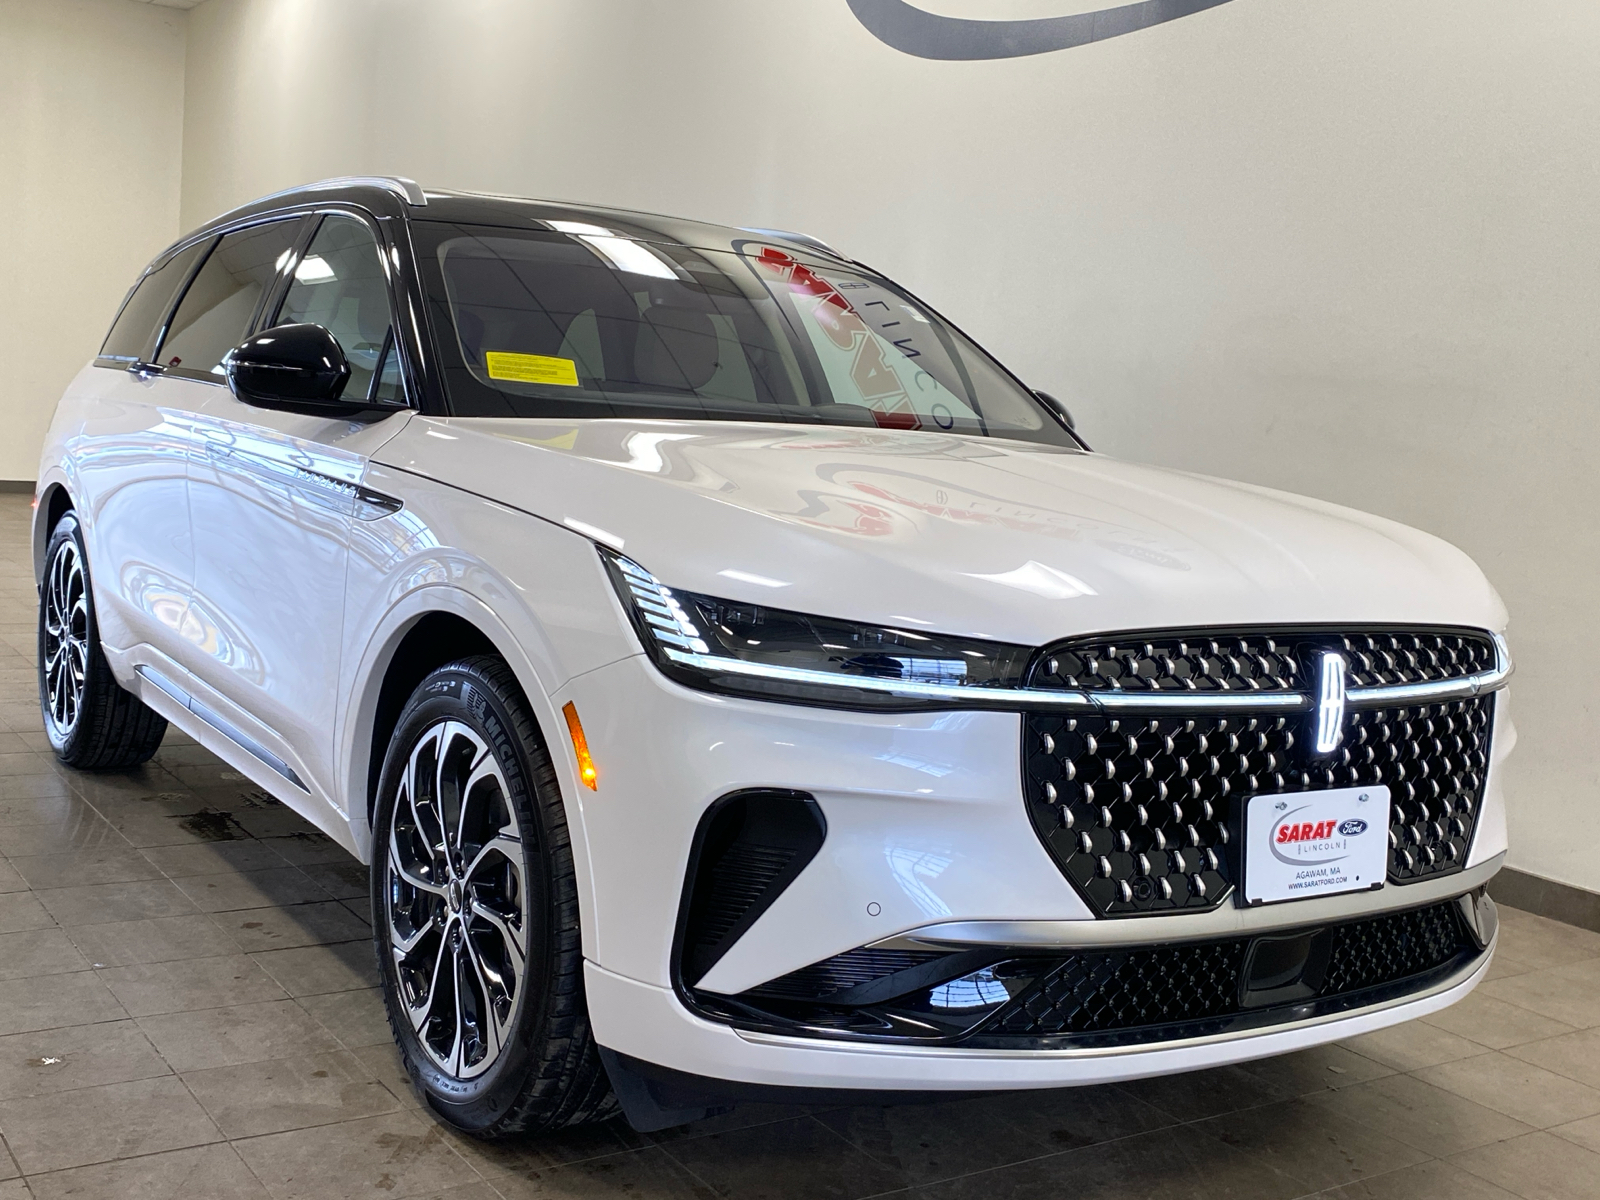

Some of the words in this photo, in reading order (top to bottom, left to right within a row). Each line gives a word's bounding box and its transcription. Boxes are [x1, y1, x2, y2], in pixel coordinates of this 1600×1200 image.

[484, 714, 535, 842] MICHELIN
[1276, 820, 1337, 844] SARAT
[1342, 820, 1364, 835] Ford
[1303, 843, 1341, 853] LINCOLN
[1295, 869, 1328, 880] AGAWAM,
[1330, 867, 1341, 875] MA
[1288, 876, 1348, 890] WWW.SARATFORD.COM
